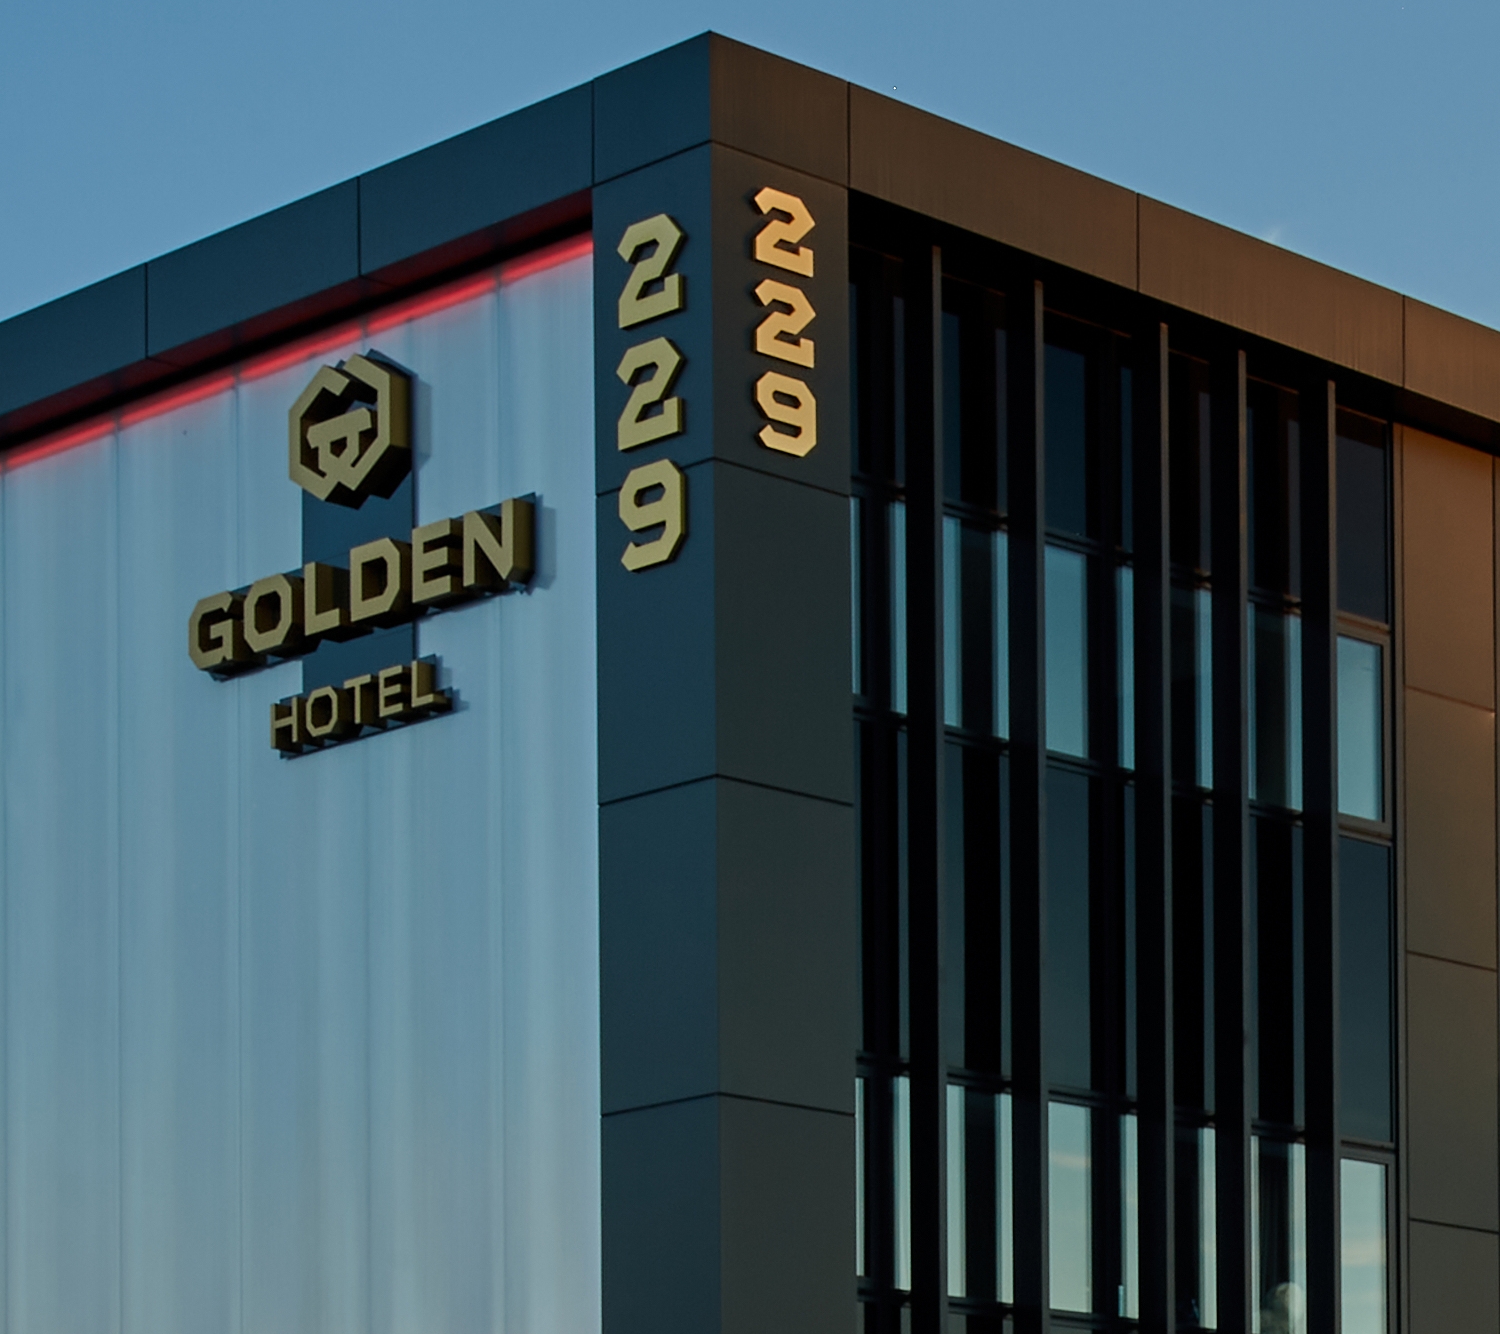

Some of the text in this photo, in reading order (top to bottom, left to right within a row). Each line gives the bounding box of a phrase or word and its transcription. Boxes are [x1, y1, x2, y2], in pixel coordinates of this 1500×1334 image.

[616, 213, 687, 572] 229
[754, 186, 817, 457] 229
[188, 496, 532, 673] GOLDEN
[270, 655, 446, 751] HOTEL
